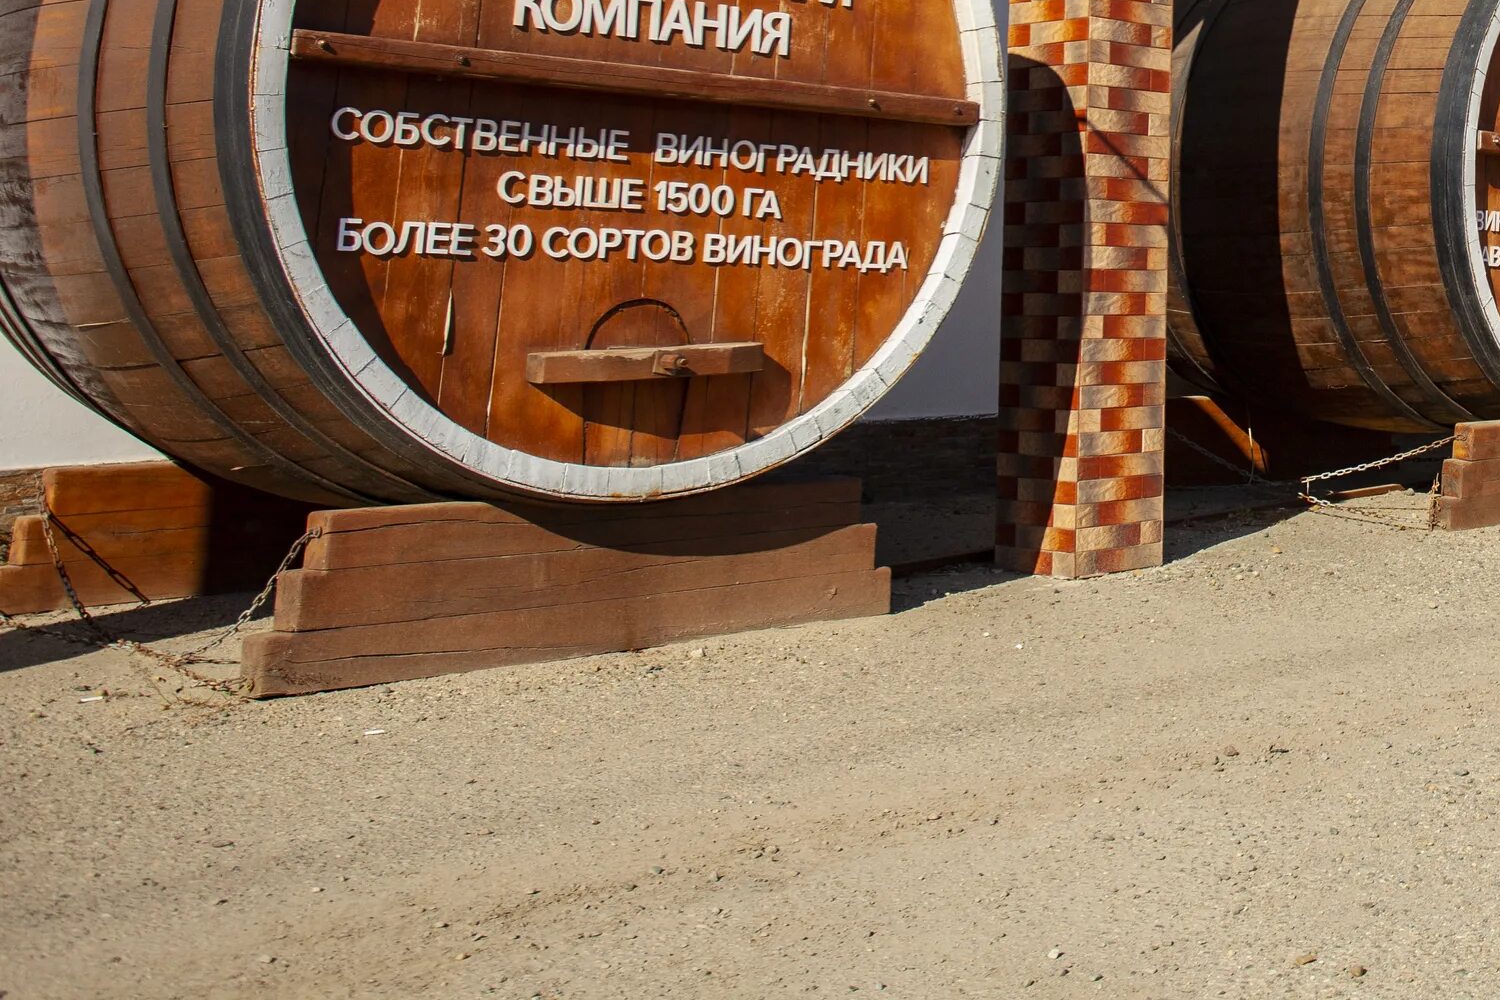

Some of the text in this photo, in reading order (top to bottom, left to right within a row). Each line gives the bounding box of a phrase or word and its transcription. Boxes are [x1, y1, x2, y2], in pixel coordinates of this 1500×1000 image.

[331, 106, 929, 184] СОБСТВЕННЫЕ ВИНОГРАДНИКИ
[497, 170, 782, 219] СВЫШЕ 1500 ГА
[337, 217, 908, 273] БОЛЕЕ 30 СОРТОВ ВИНОГРАДА
